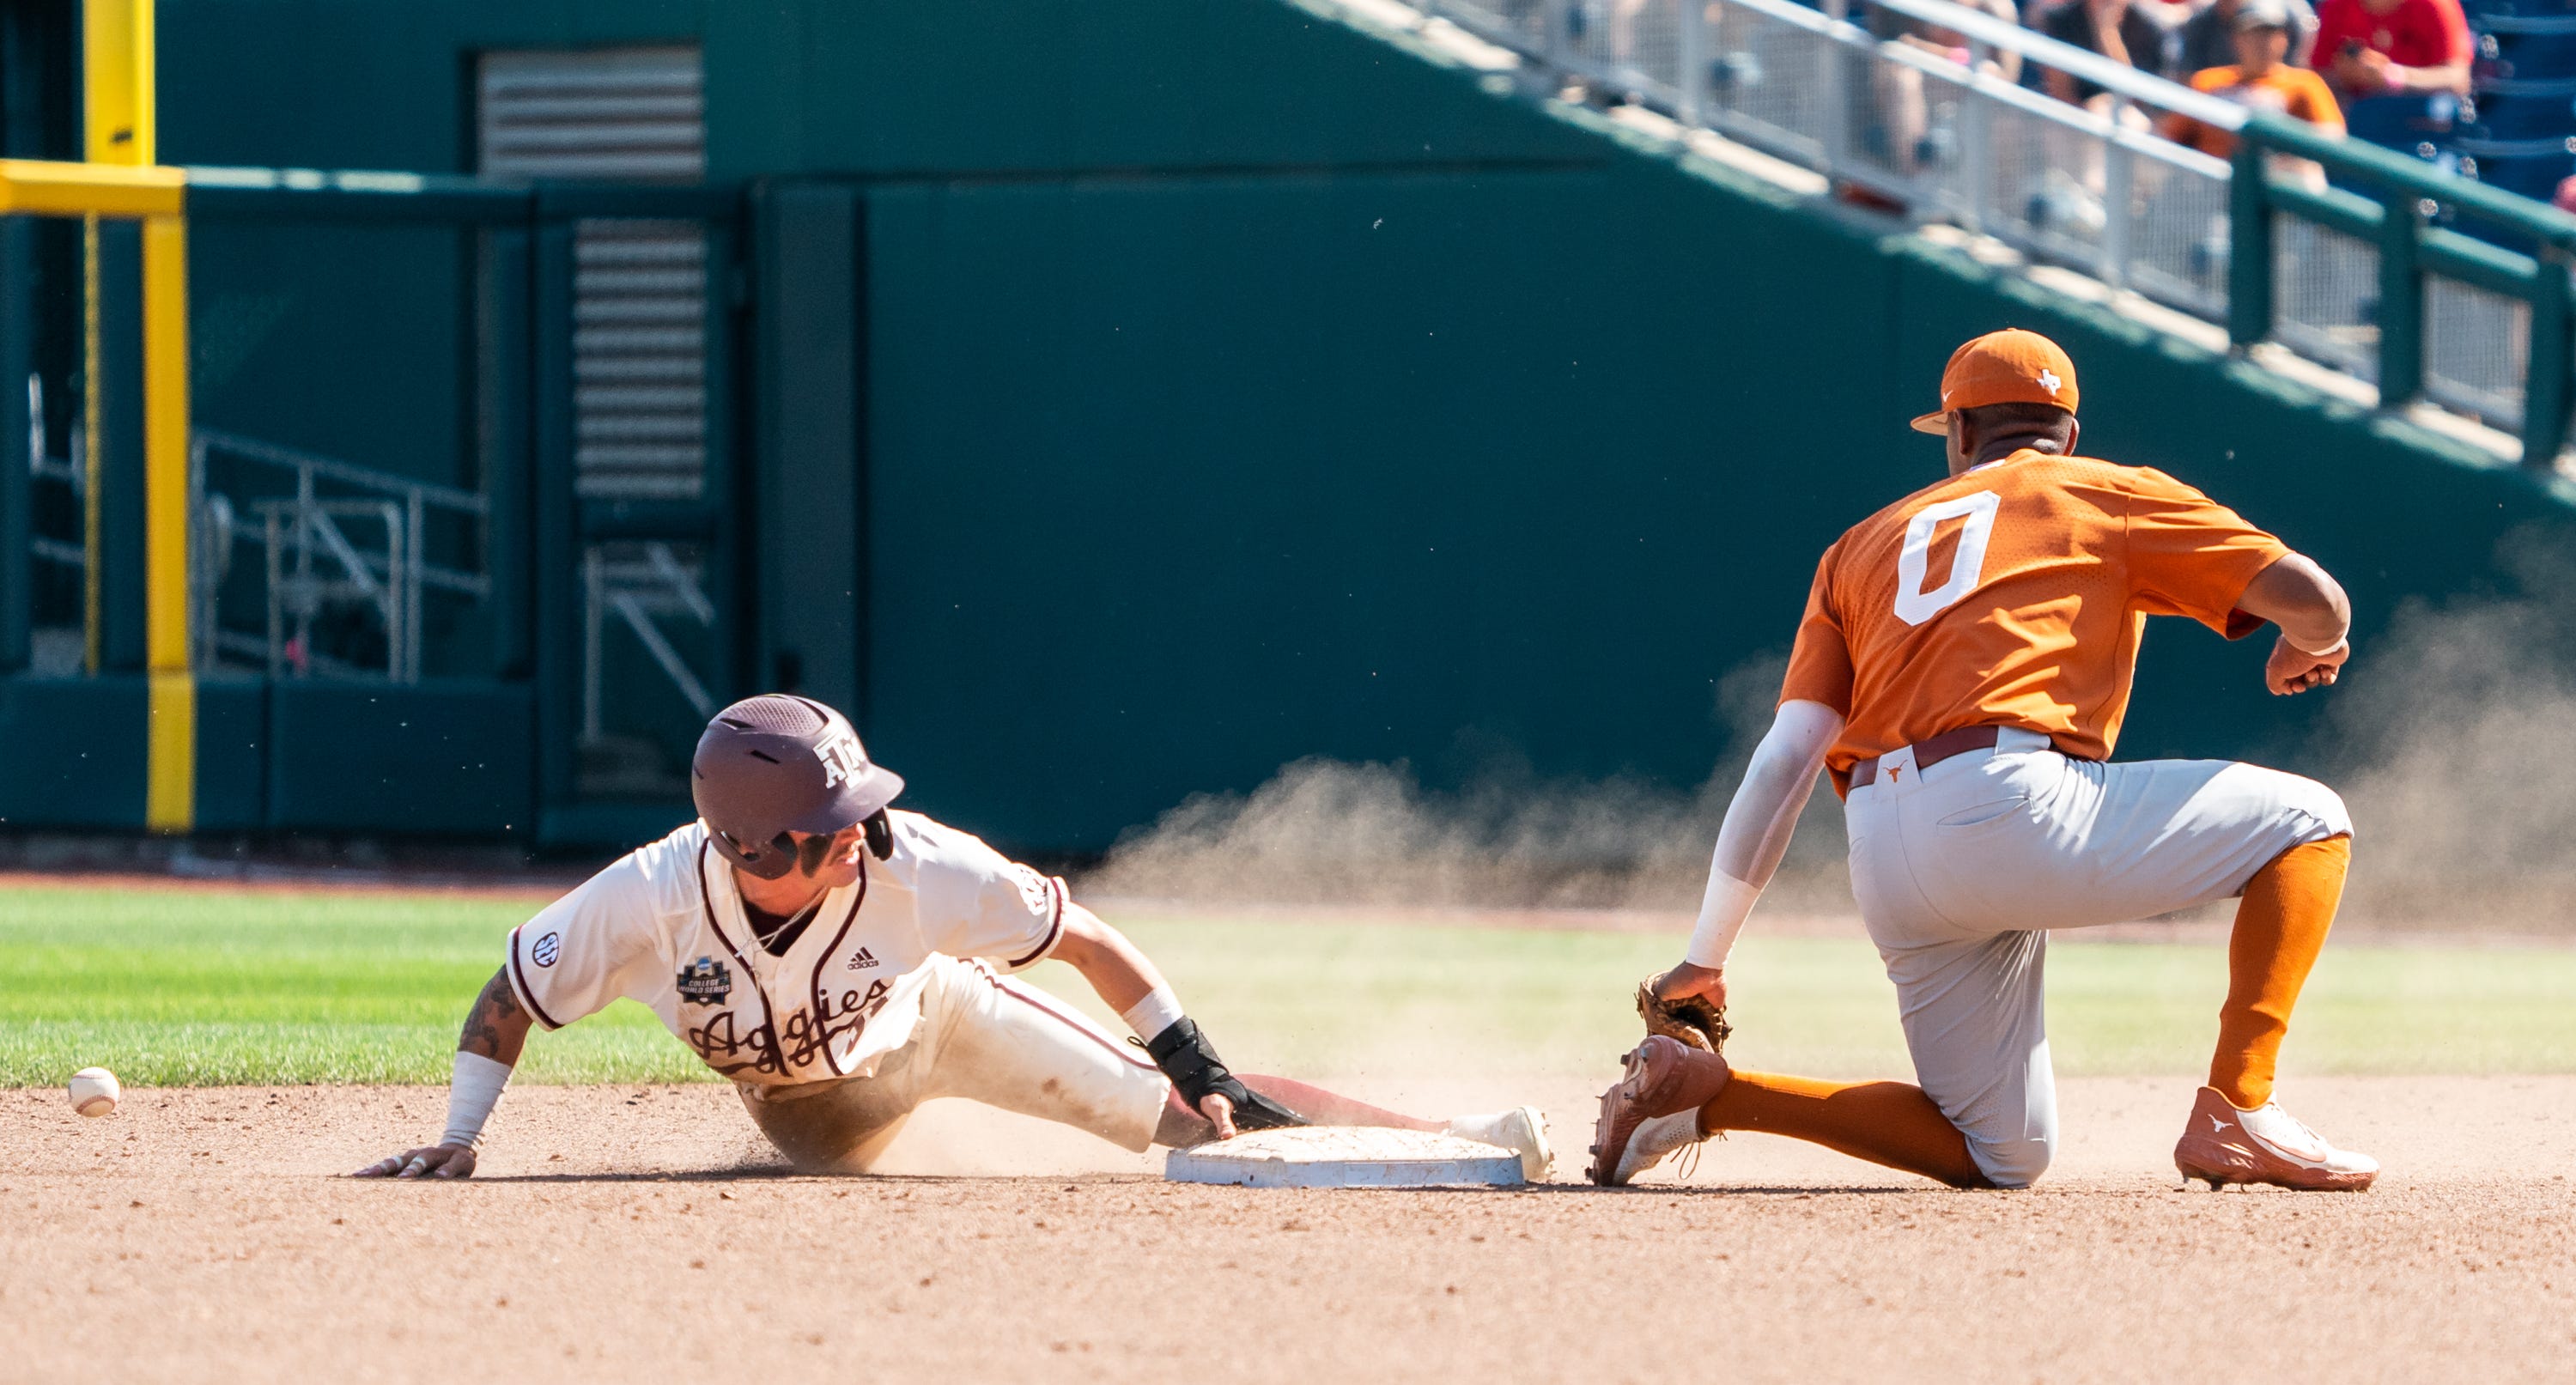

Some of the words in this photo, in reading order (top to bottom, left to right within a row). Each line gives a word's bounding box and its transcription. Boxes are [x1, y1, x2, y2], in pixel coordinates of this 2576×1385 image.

[1893, 489, 2001, 626] 0
[847, 959, 879, 970] adidas
[689, 979, 720, 987] COLLEGE
[679, 986, 704, 994] WORLD
[704, 984, 730, 994] SERIES
[689, 978, 893, 1073] Aggies
